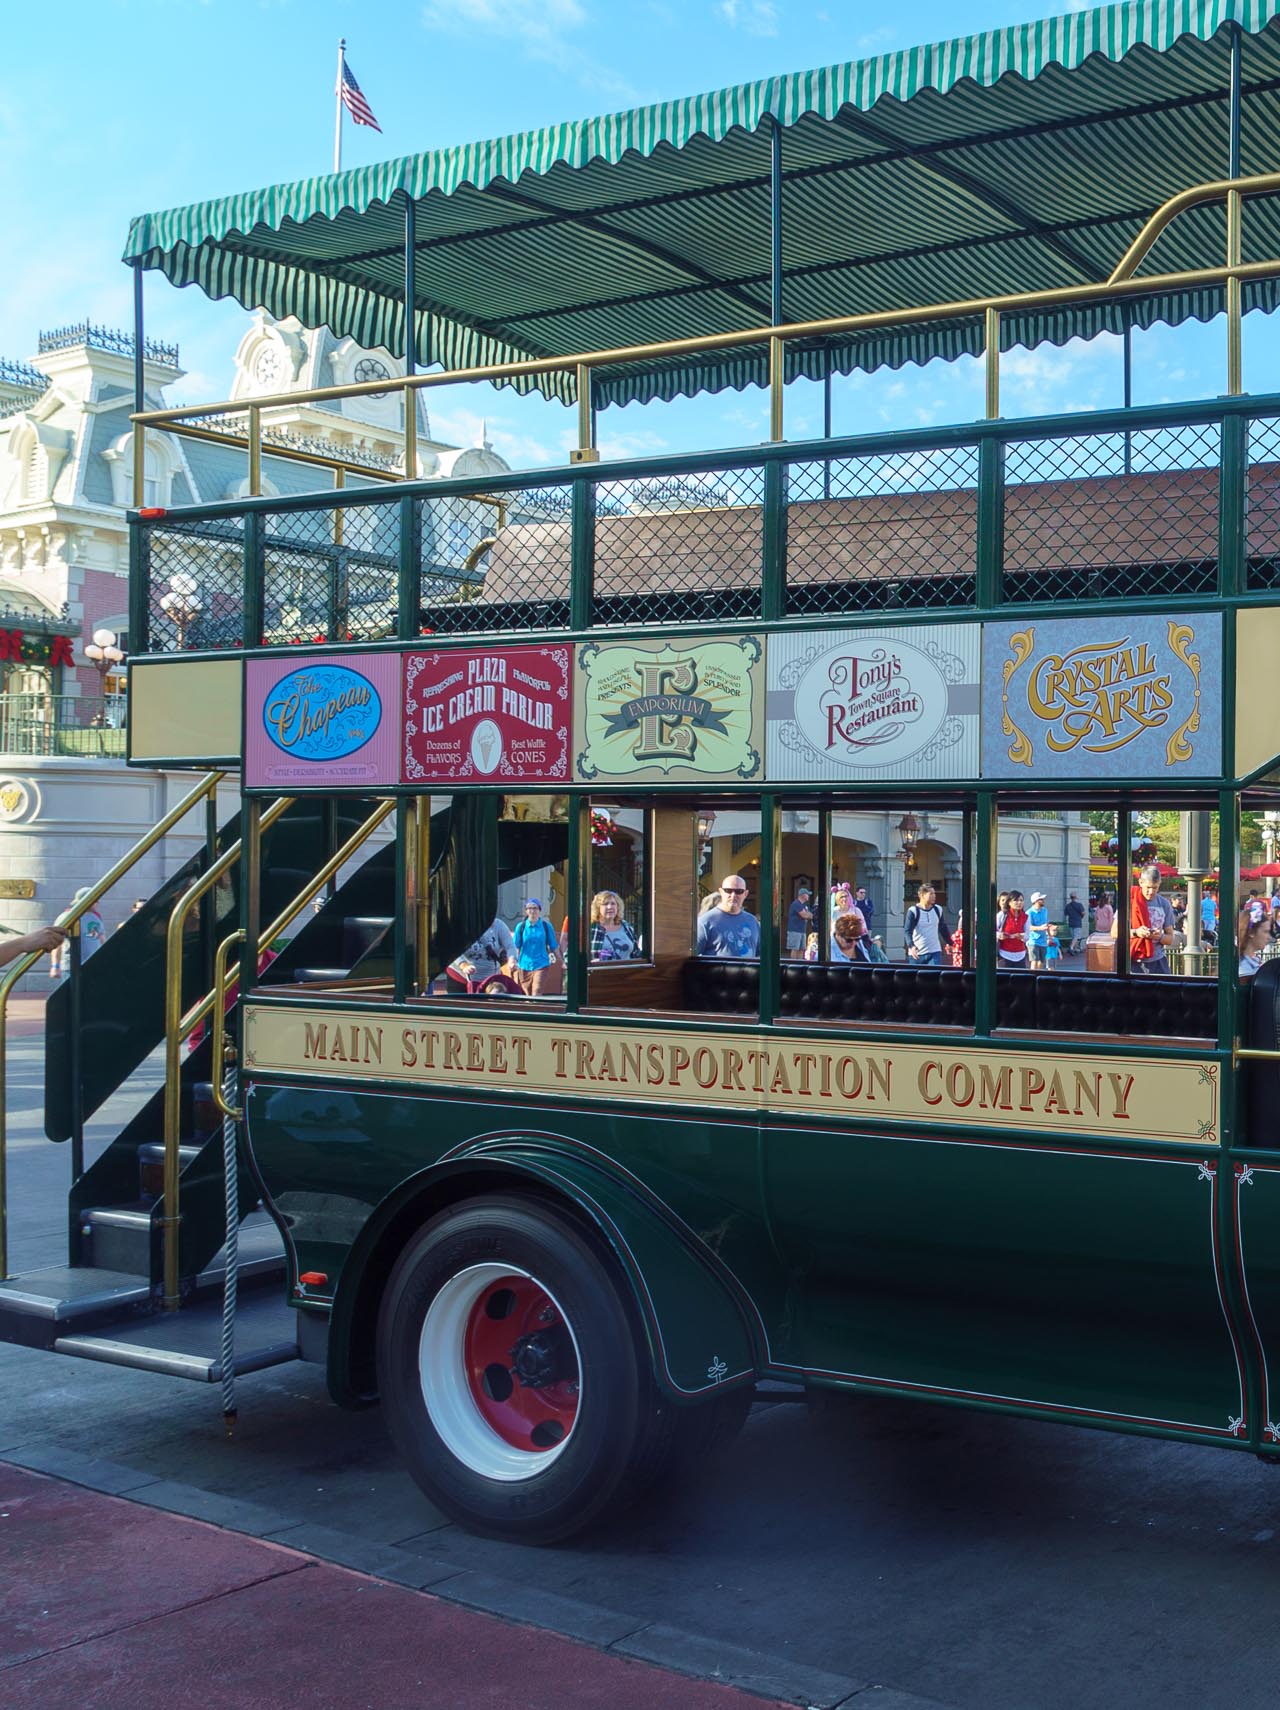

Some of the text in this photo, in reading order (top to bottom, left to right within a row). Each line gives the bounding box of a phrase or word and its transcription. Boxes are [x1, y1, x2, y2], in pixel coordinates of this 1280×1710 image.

[468, 657, 507, 685] PLAZA
[829, 648, 901, 702] Tony's
[1028, 637, 1155, 719] CRYSTAL
[293, 674, 323, 697] The
[703, 679, 741, 697] SPLENDOR
[422, 685, 553, 733] ICE CREAM PARLOR
[628, 697, 705, 717] EMPORIUM
[848, 687, 901, 716] Town Square
[1047, 675, 1172, 752] ARTS
[267, 693, 371, 747] Chapeau
[825, 697, 918, 751] Restaurant
[426, 740, 461, 750] Dozens of
[426, 752, 462, 764] FLAVORS
[511, 739, 547, 749] Best Waffle
[511, 751, 546, 763] CONES
[304, 1022, 1135, 1119] MAIN STREET TRANSPORTATION COMPANY
